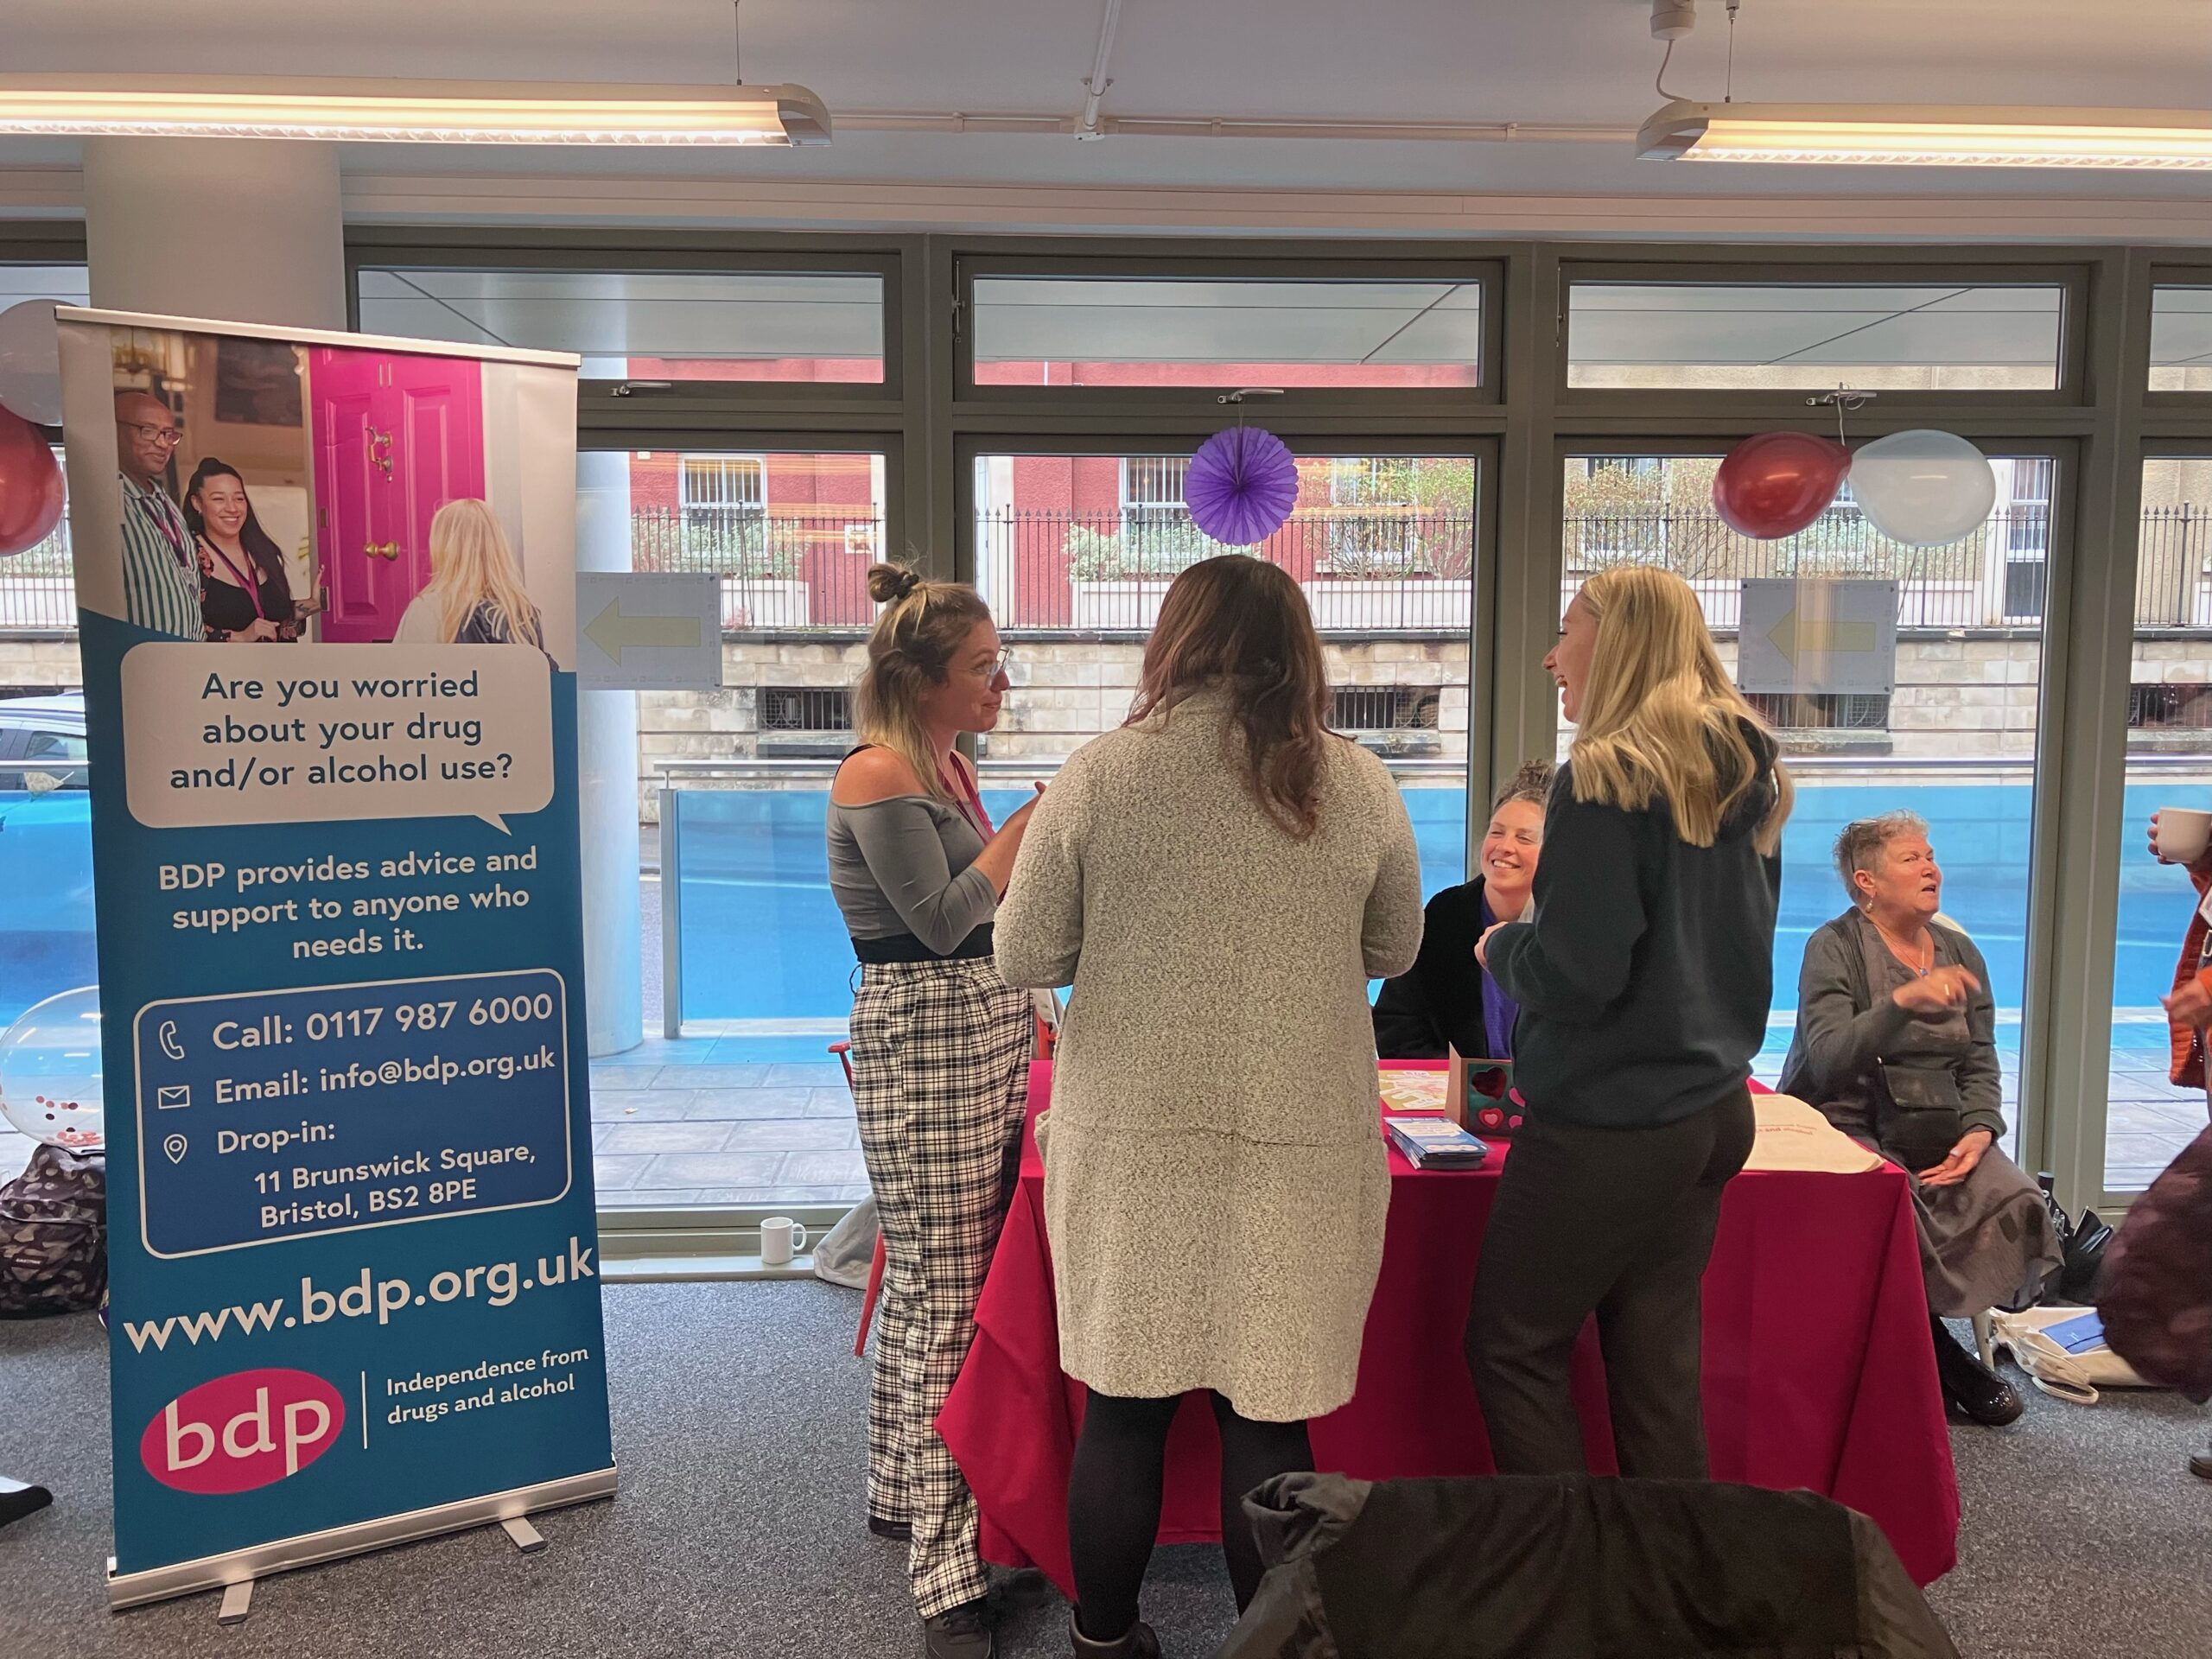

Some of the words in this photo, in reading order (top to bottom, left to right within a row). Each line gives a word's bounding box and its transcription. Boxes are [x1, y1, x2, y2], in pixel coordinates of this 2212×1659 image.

[201, 672, 264, 700] Are
[276, 680, 339, 708] you
[351, 670, 478, 698] worried
[202, 715, 307, 744] about
[318, 721, 395, 750] your
[406, 711, 481, 747] drug
[170, 756, 296, 791] and/or
[308, 753, 427, 785] alcohol
[441, 753, 512, 780] use?
[159, 862, 226, 890] BDP
[237, 855, 370, 893] provides
[380, 850, 476, 878] advice
[486, 845, 537, 872] and
[173, 899, 298, 934] support
[308, 898, 342, 919] to
[353, 893, 460, 922] anyone
[468, 883, 530, 909] who
[293, 928, 383, 959] needs
[393, 927, 423, 951] it.
[213, 1014, 293, 1050] Call:
[306, 1007, 384, 1040] 0117
[395, 1001, 457, 1033] 987
[468, 993, 553, 1026] 6000
[215, 1069, 308, 1104] Email:
[320, 1045, 556, 1091] info@bdp.org.uk
[218, 1120, 335, 1154] Drop-in:
[254, 1170, 280, 1194] 11
[292, 1151, 431, 1191] Brunswick
[440, 1146, 536, 1173] Square,
[261, 1192, 359, 1229] Bristol,
[369, 1185, 419, 1212] BS2
[429, 1178, 477, 1204] 8PE
[123, 1236, 594, 1354] www.bdp.org.uk
[387, 1358, 537, 1396] Independence
[541, 1349, 589, 1368] from
[387, 1402, 448, 1425] drugs
[454, 1387, 495, 1412] and
[500, 1373, 575, 1403] alcohol
[165, 1386, 331, 1478] bdp
